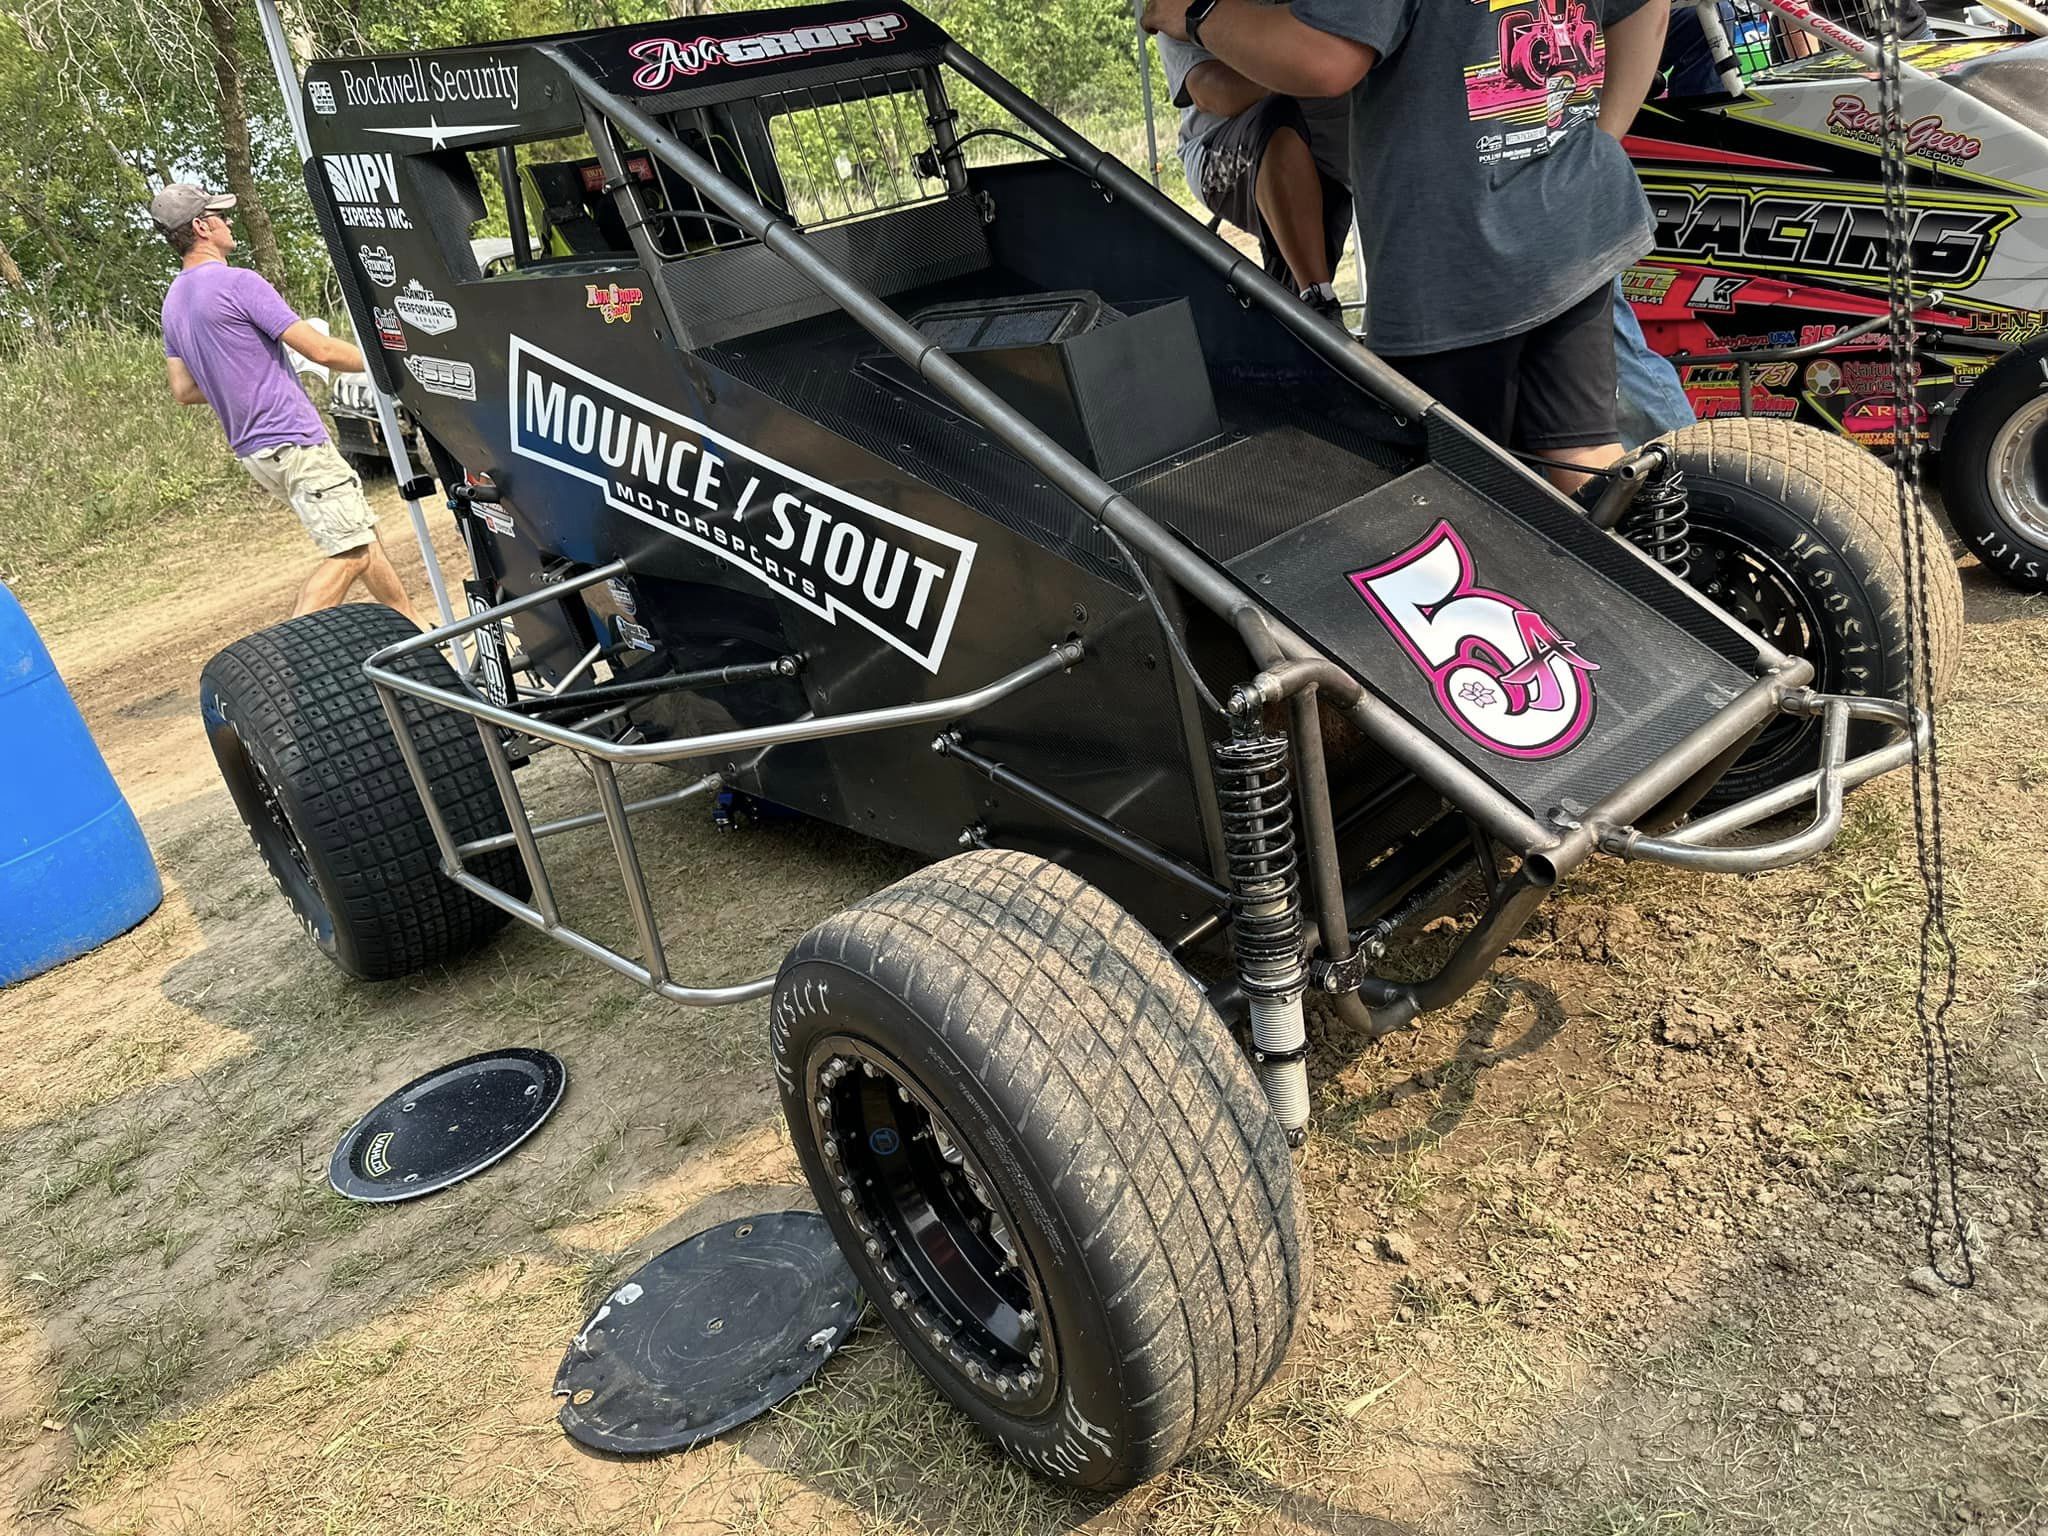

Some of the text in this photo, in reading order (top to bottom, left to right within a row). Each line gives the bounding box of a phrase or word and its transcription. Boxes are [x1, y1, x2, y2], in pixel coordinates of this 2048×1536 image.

[636, 14, 901, 86] Ava GROPP
[1810, 17, 1865, 52] Chassis
[340, 56, 519, 110] Rockwell Security
[1905, 116, 1982, 160] Geese
[1917, 146, 1965, 167] DECOYS
[340, 153, 400, 204] MPV
[339, 206, 413, 230] EXPRESS INC.
[1654, 196, 1998, 280] RACING
[397, 301, 454, 319] PERFORMANCE
[525, 369, 947, 630] MOUNCE / STOUT
